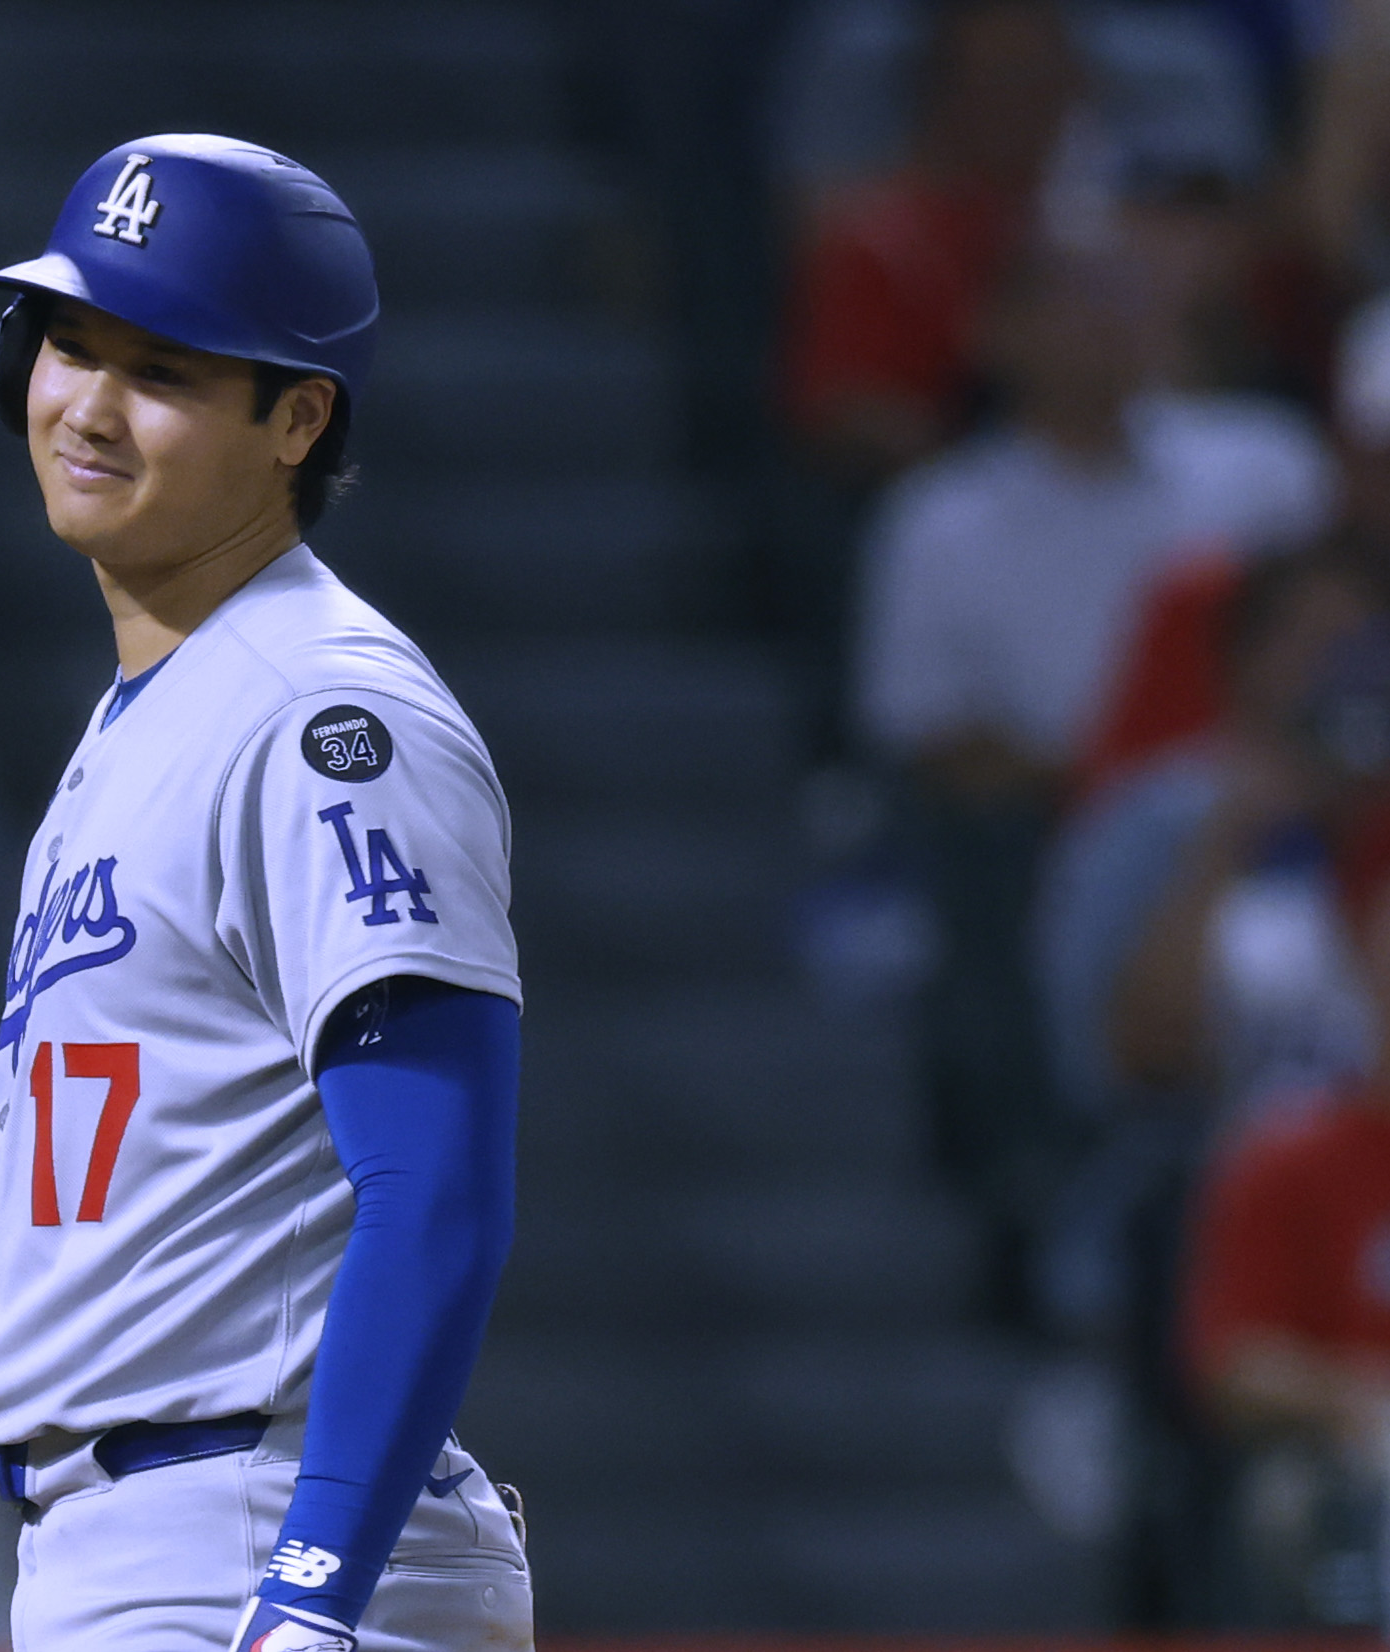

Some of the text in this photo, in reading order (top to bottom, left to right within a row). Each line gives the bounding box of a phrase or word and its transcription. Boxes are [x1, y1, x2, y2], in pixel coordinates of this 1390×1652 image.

[93, 153, 159, 244] LA
[312, 718, 368, 739] FERNANDO
[321, 731, 377, 771] 34
[317, 801, 439, 926] LA
[30, 1041, 141, 1226] 17
